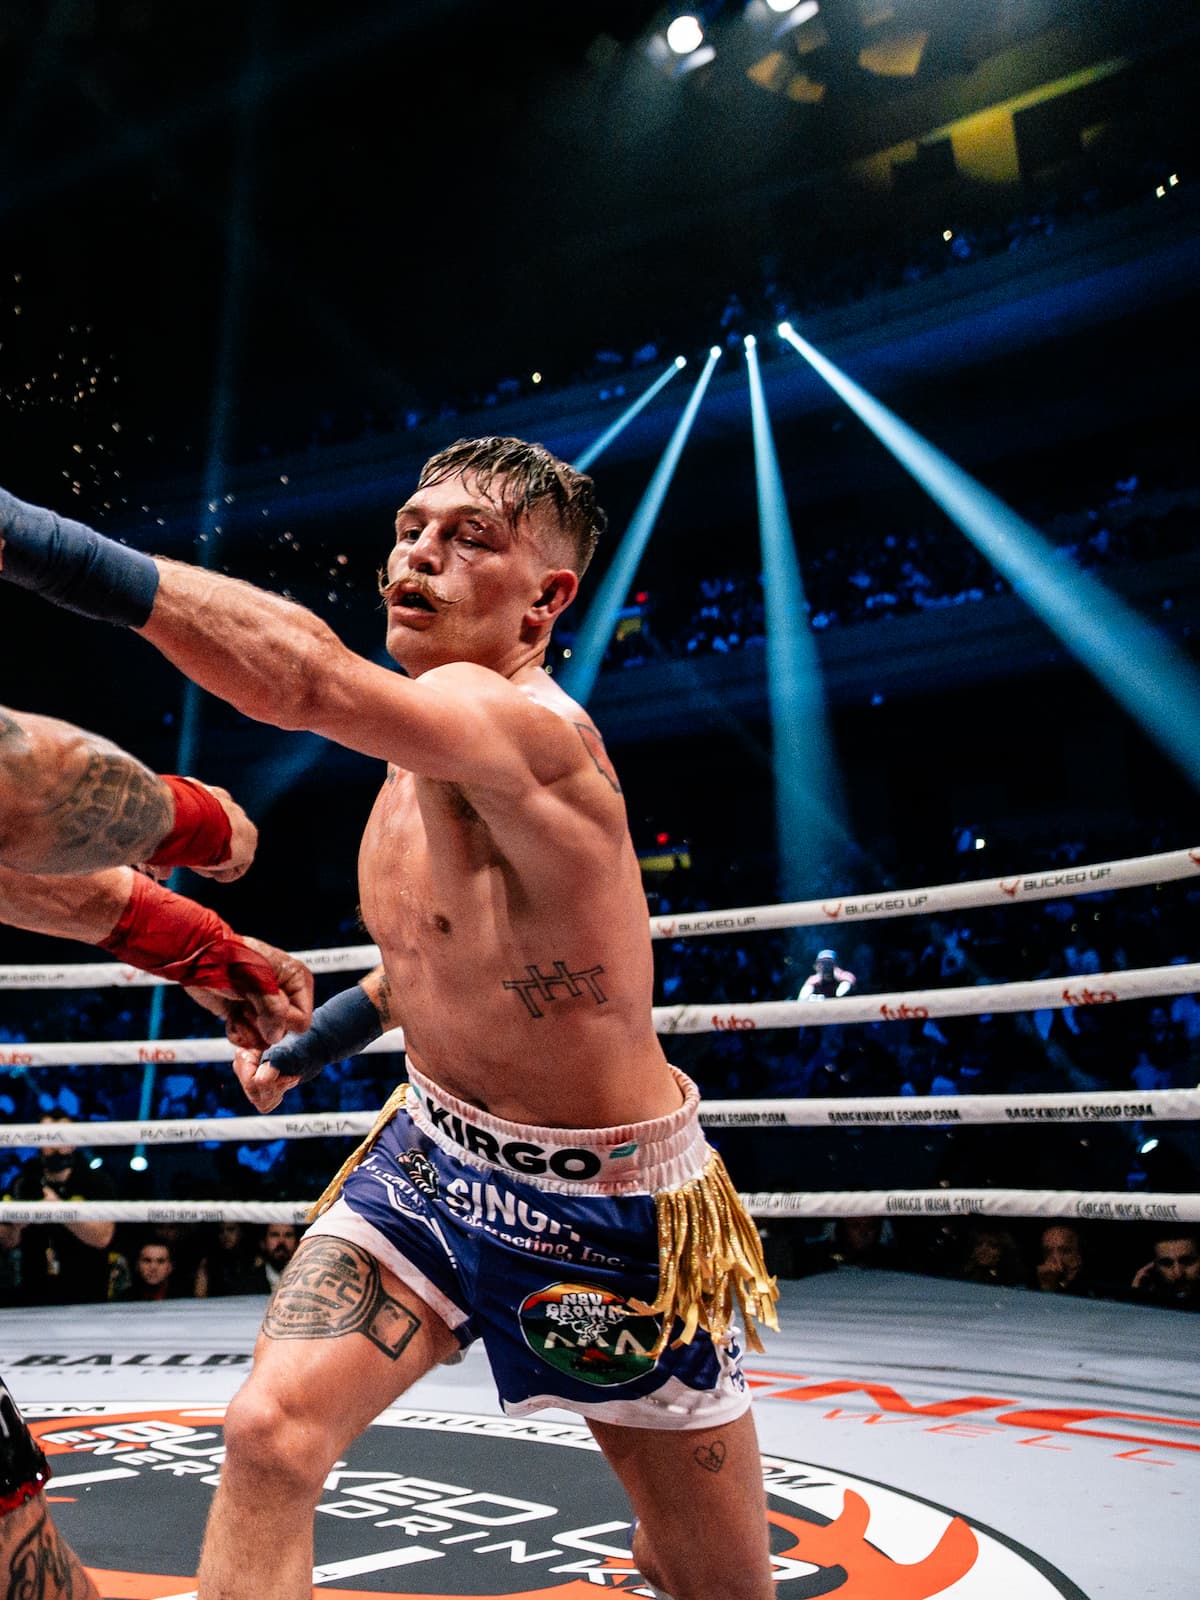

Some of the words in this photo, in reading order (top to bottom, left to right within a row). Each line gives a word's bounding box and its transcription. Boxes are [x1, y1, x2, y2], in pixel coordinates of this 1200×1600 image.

[1024, 871, 1087, 891] BUCKED
[1089, 867, 1111, 880] UP
[845, 899, 905, 915] BUCKED
[907, 895, 928, 908] UP
[678, 918, 734, 932] BUCKED
[737, 916, 756, 927] UP
[711, 1015, 756, 1031] fubo
[880, 1003, 929, 1021] fubo
[138, 1047, 176, 1063] fubo
[426, 1096, 602, 1181] KIRGO
[580, 1244, 626, 1268] Inc.
[401, 1415, 594, 1442] BUCKE
[822, 1408, 1177, 1466] WELL
